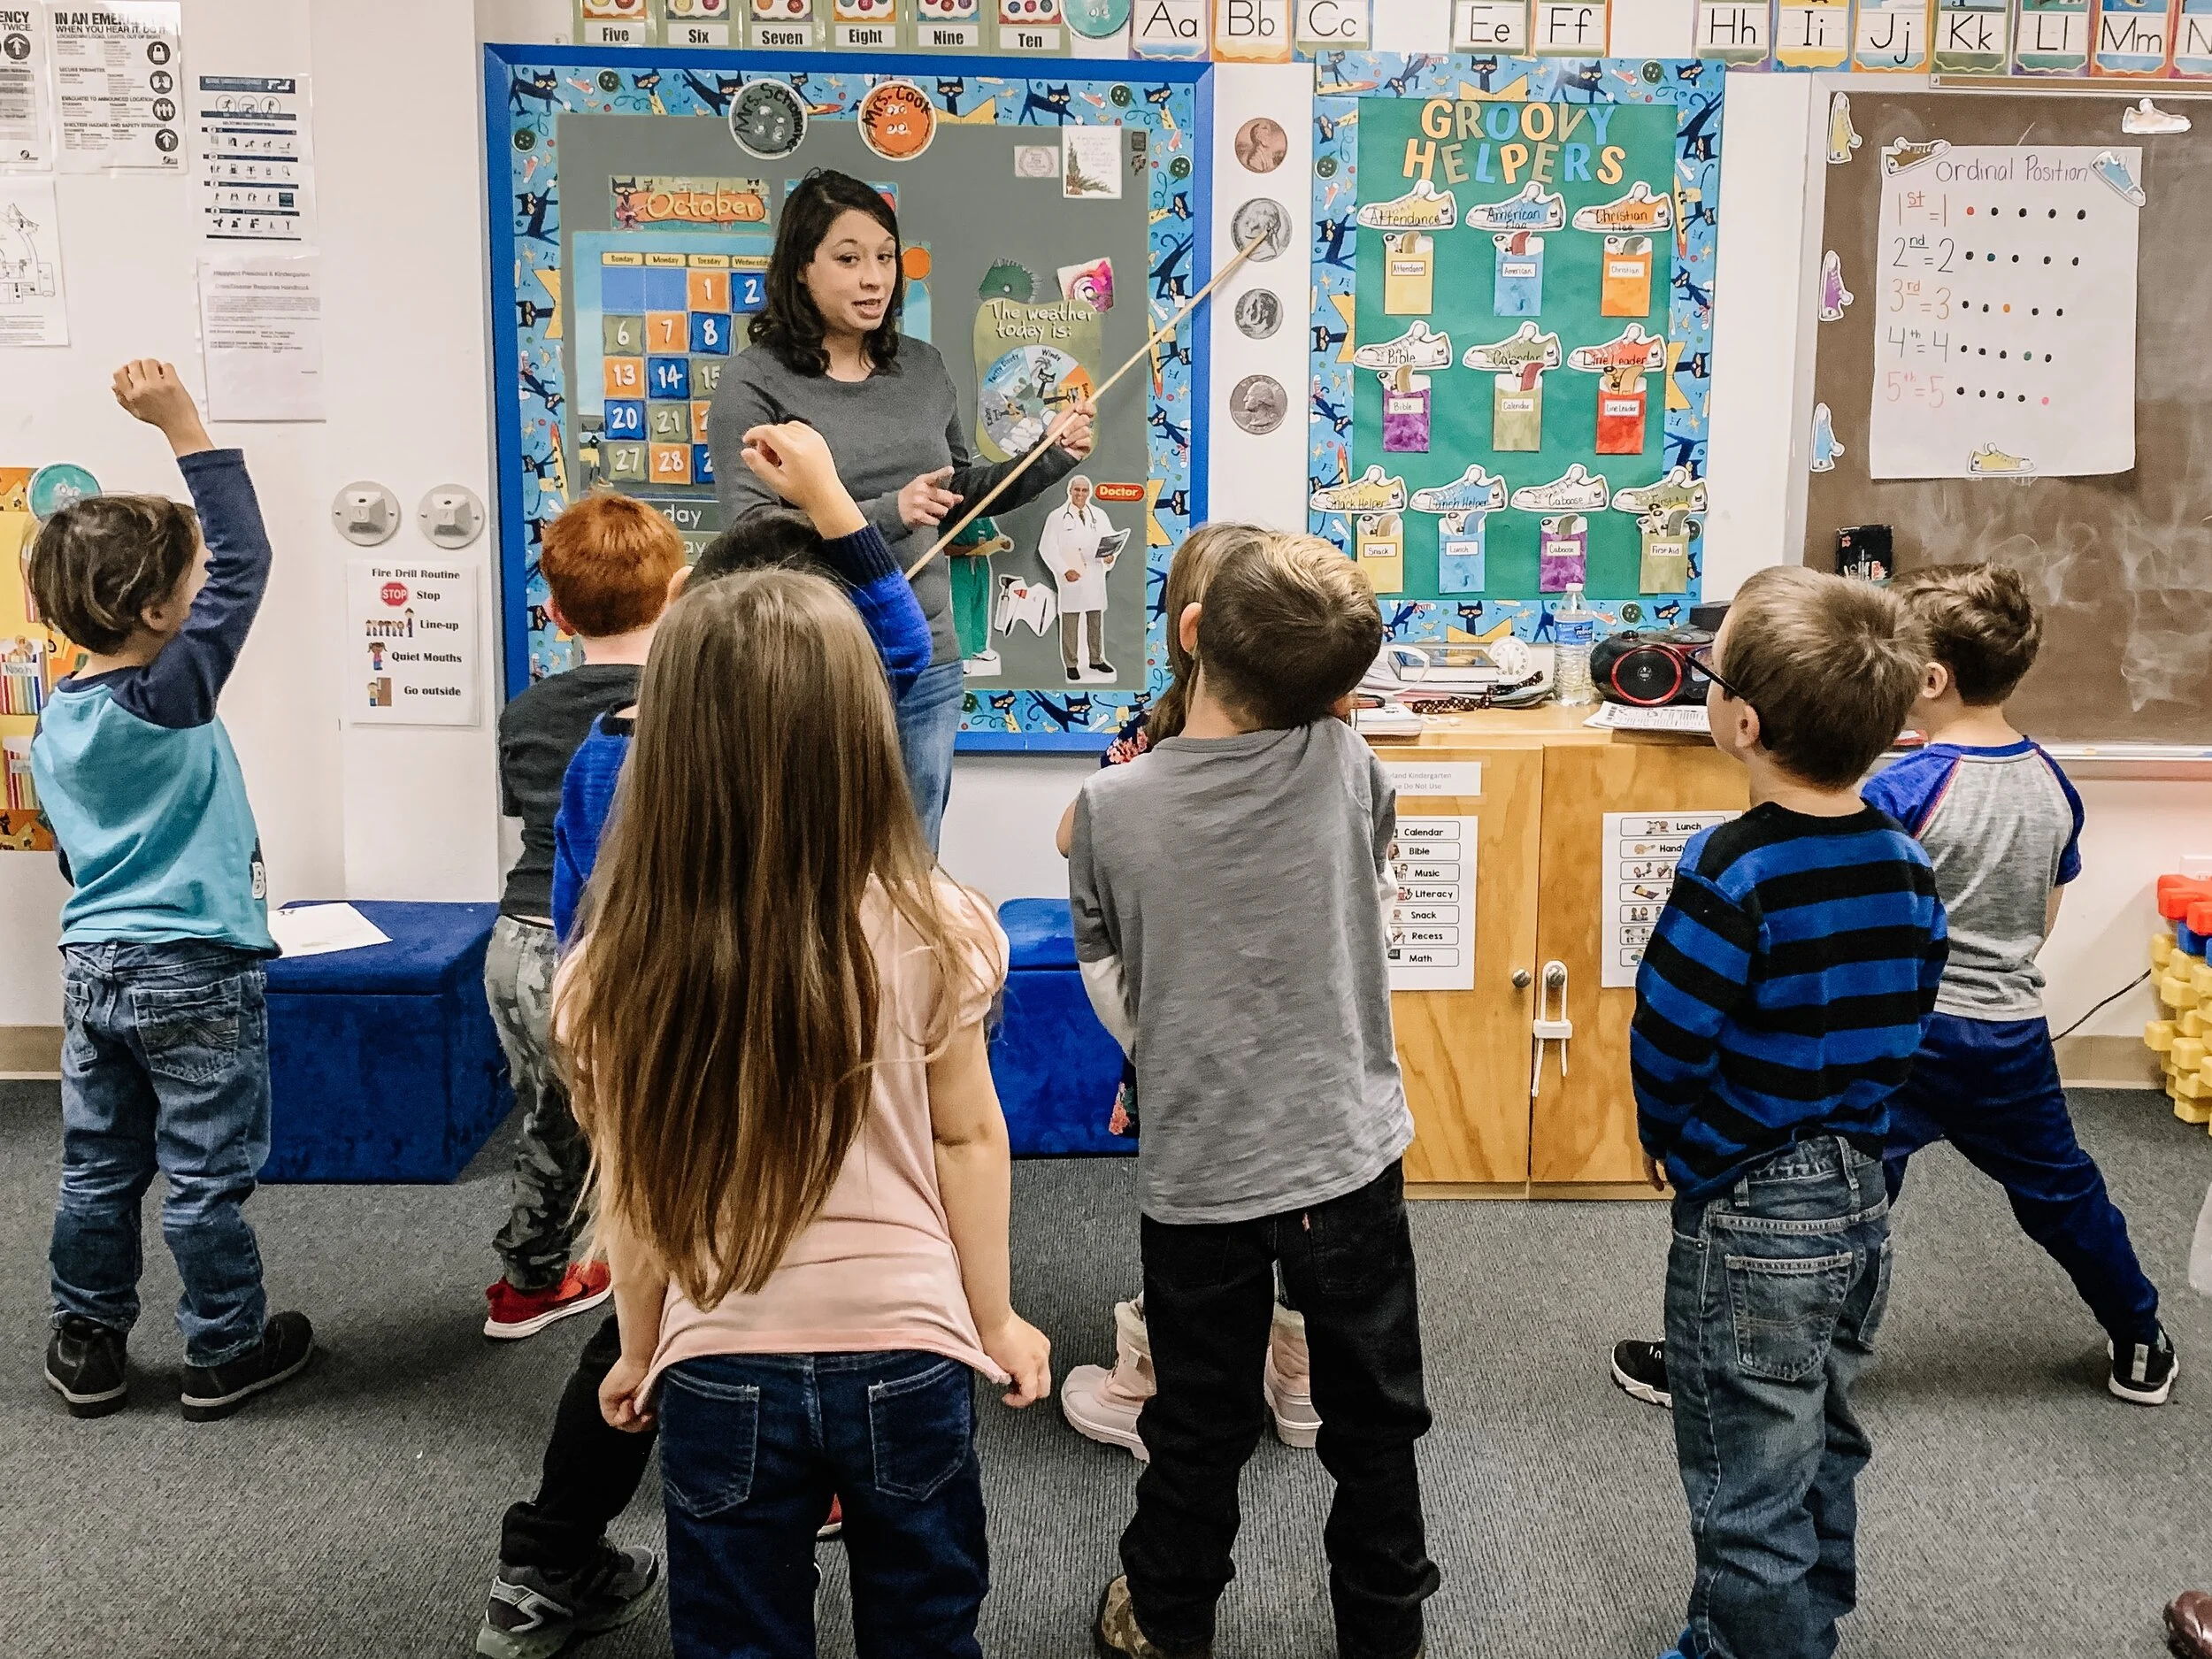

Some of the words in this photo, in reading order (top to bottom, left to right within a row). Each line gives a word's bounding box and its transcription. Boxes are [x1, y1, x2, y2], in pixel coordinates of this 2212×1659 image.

[55, 12, 68, 25] IN
[72, 12, 88, 25] AN
[1142, 1, 1197, 37] Aa
[1228, 0, 1275, 36] Bb
[1309, 1, 1356, 37] Cc
[1470, 6, 1510, 42] Ee
[1549, 7, 1592, 43] Ff
[1710, 8, 1756, 44] Hh
[602, 27, 630, 42] Five
[688, 28, 709, 43] Six
[1802, 10, 1824, 46] Ii
[1949, 14, 1993, 50] Kk
[2036, 15, 2069, 50] Ll
[2101, 16, 2162, 53] Mm
[762, 30, 803, 45] Seven
[849, 29, 883, 44] Eight
[933, 30, 964, 45] Nine
[1018, 33, 1042, 48] Ten
[1870, 13, 1910, 64] Jj
[862, 96, 893, 128] Mrs.
[896, 86, 932, 113] Cook
[1421, 99, 1616, 145] GROOVY
[1402, 137, 1626, 185] HELPERS
[1936, 157, 2014, 182] Ordinal
[2025, 154, 2088, 182] Position
[646, 181, 757, 219] October
[1371, 210, 1440, 226] Attendance
[1487, 207, 1541, 221] American
[1596, 209, 1647, 223] Christian
[653, 256, 679, 265] Monday
[703, 278, 712, 301] 1
[745, 279, 761, 304] 2
[986, 300, 1019, 320] The
[1026, 302, 1096, 321] weather
[617, 320, 630, 346] 6
[661, 319, 674, 343] 7
[703, 319, 718, 346] 8
[996, 321, 1045, 343] today
[1051, 322, 1072, 339] is:
[1041, 349, 1062, 362] Windy
[1387, 349, 1416, 365] Bible
[1584, 350, 1609, 365] Line
[613, 365, 636, 387] 13
[658, 365, 683, 389] 14
[611, 407, 637, 430] 20
[657, 411, 680, 434] 21
[616, 448, 640, 473] 27
[658, 450, 684, 473] 28
[1099, 486, 1139, 497] Doctor
[1326, 495, 1356, 510] Snack
[1358, 497, 1386, 511] Helper
[1462, 496, 1489, 509] Helper
[1548, 494, 1583, 506] Caboose
[1368, 547, 1389, 556] Snack
[1549, 543, 1574, 553] Caboose
[372, 568, 392, 578] Fire
[396, 569, 418, 578] Drill
[420, 570, 460, 580] Routine
[382, 588, 407, 600] STOP
[417, 590, 441, 601] Stop
[419, 619, 459, 631] Line-up
[391, 651, 420, 662] Quiet
[423, 652, 462, 663] Mouths
[404, 686, 419, 695] Go
[422, 686, 461, 696] outside
[1409, 847, 1430, 856] Bible
[1415, 890, 1453, 899] Literacy
